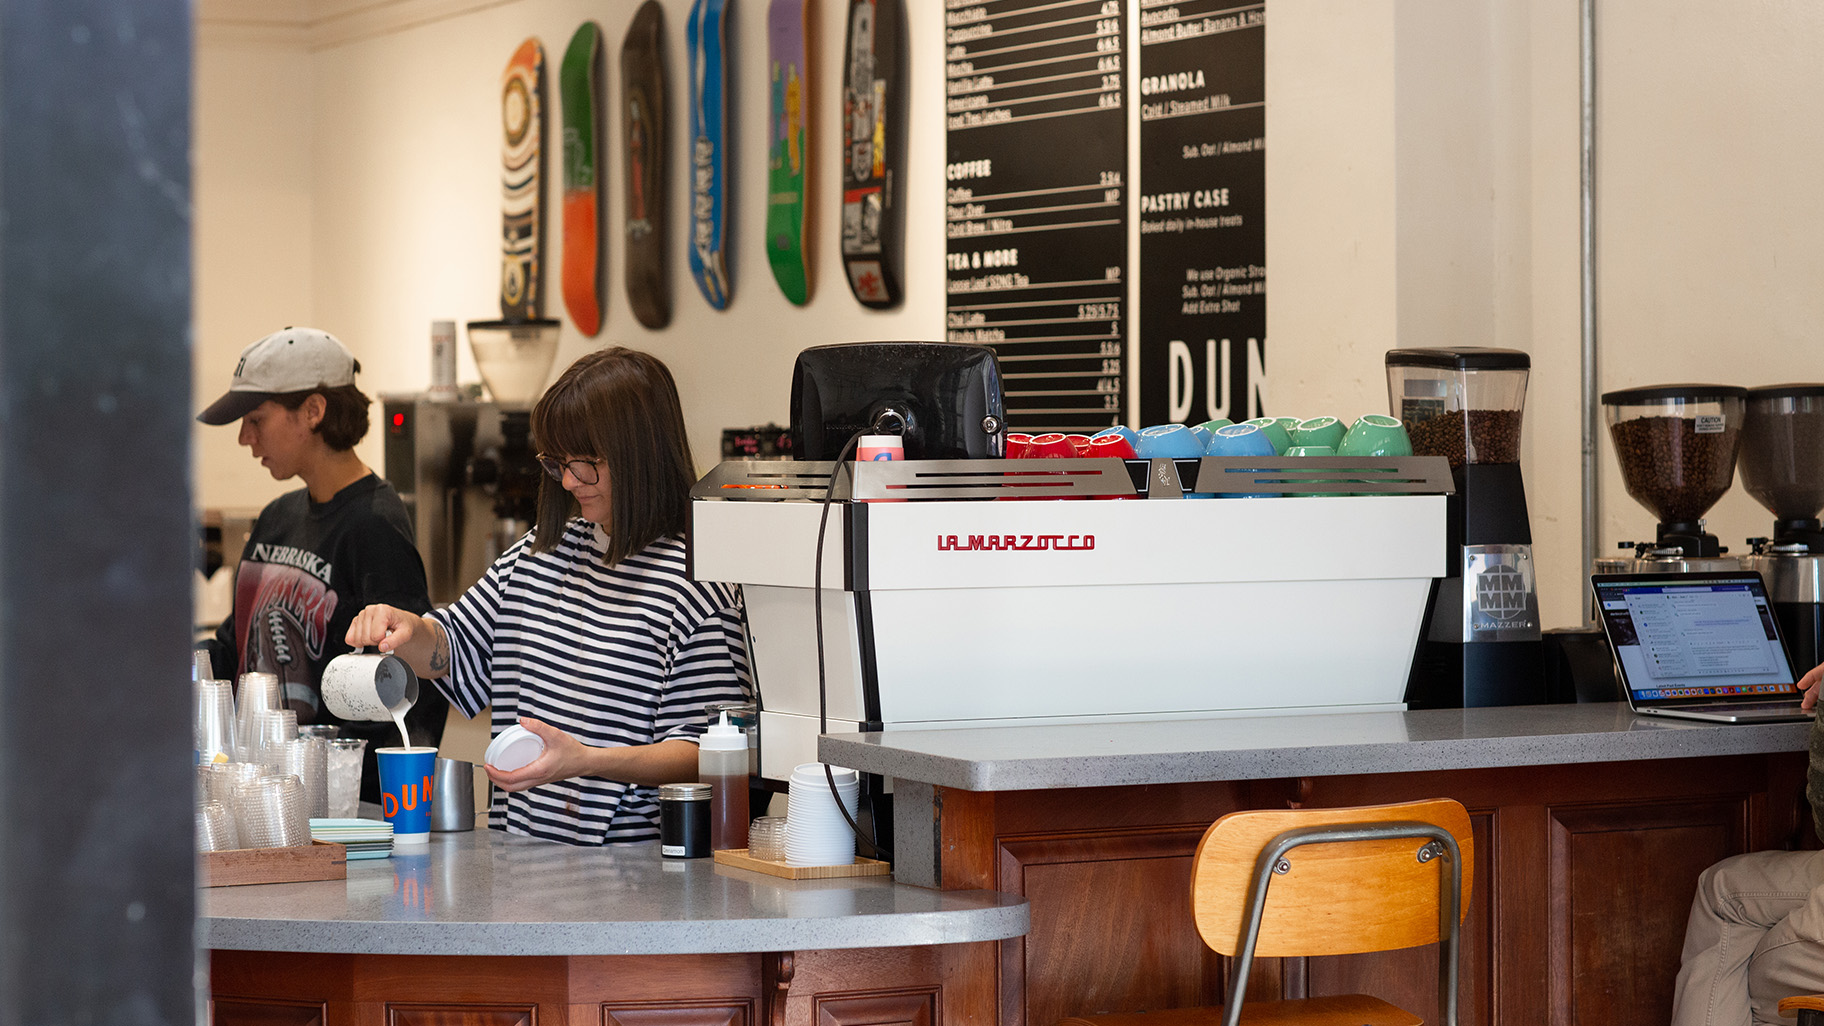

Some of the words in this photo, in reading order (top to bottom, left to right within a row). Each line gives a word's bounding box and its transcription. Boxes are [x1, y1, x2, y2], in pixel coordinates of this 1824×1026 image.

[1203, 18, 1237, 34] Banana
[1141, 70, 1205, 95] GRANOLA
[1142, 102, 1163, 119] Cold
[1170, 96, 1209, 115] Steamed
[1210, 93, 1231, 109] Milk
[1222, 139, 1252, 154] Almond
[947, 159, 992, 181] COFFEE
[1141, 192, 1190, 213] PASTRY
[1194, 188, 1229, 208] CASE
[1166, 218, 1184, 233] daily
[1185, 217, 1218, 230] in-house
[1220, 215, 1243, 228] treats
[947, 252, 970, 271] TEA
[971, 251, 981, 269] &
[983, 248, 1018, 268] MORE
[1186, 268, 1199, 281] We
[1200, 269, 1214, 281] use
[1215, 265, 1247, 282] Organic
[1222, 282, 1252, 295] Almond
[1200, 300, 1220, 314] Extra
[1221, 299, 1241, 313] Shot
[938, 535, 958, 550] LA
[969, 535, 1095, 550] MARZOCCO
[251, 543, 332, 585] NEBRASKA
[1480, 620, 1526, 629] MAZZER
[383, 775, 433, 817] DUN
